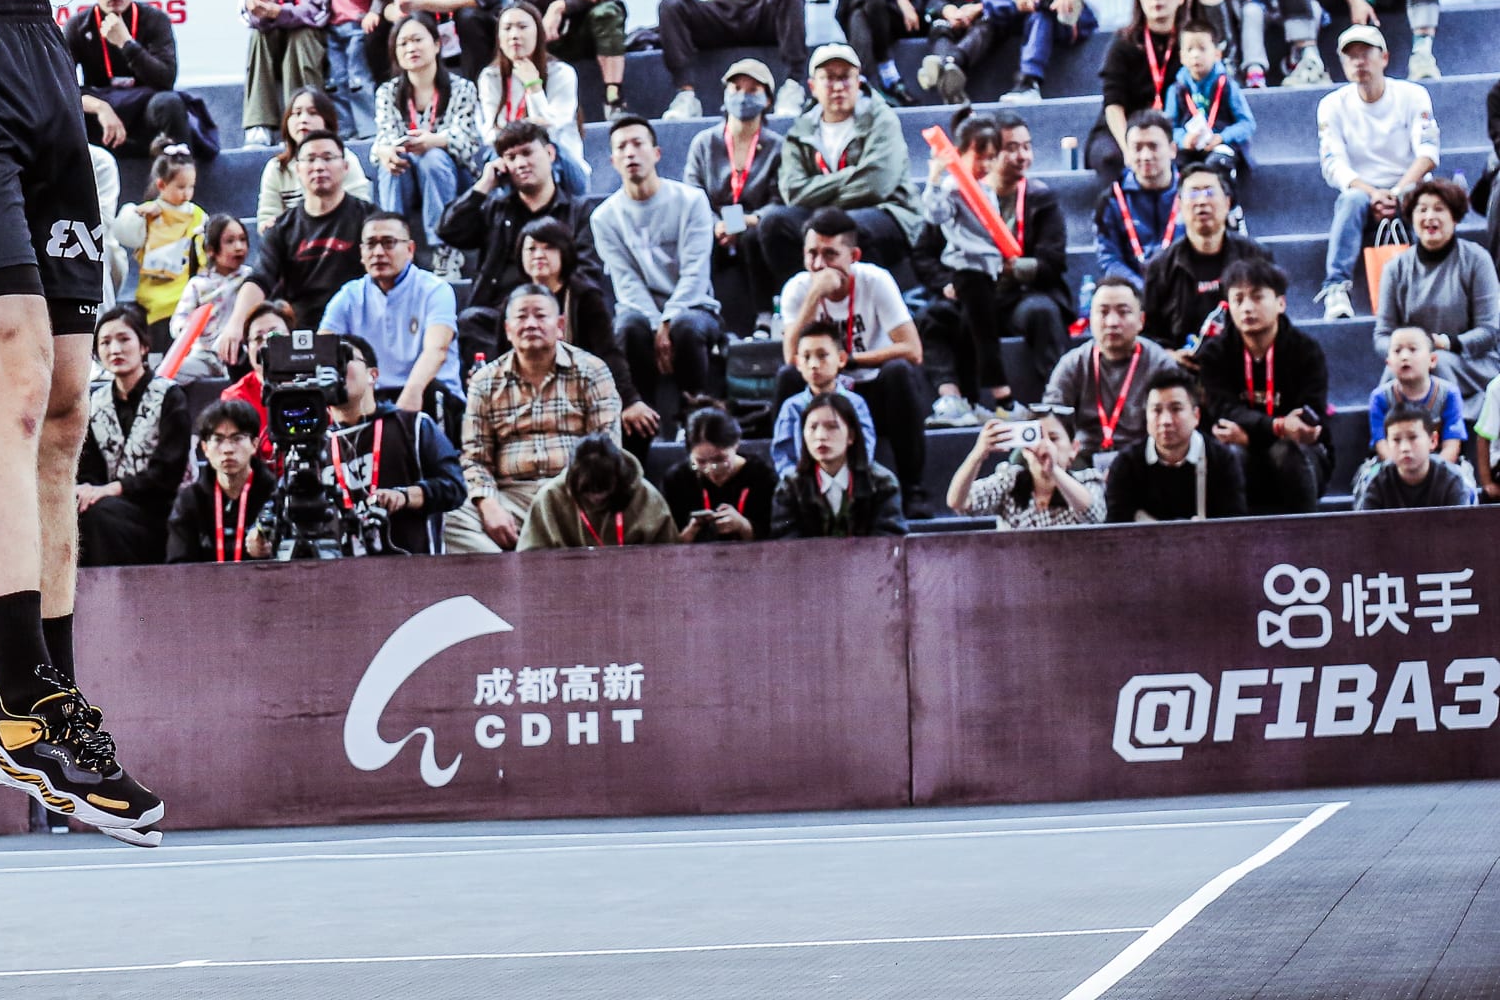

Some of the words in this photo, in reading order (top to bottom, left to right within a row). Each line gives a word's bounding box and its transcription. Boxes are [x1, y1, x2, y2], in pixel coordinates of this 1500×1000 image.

[1342, 567, 1481, 637] 快手
[473, 661, 645, 706] 成都高新
[474, 708, 644, 750] CDHT
